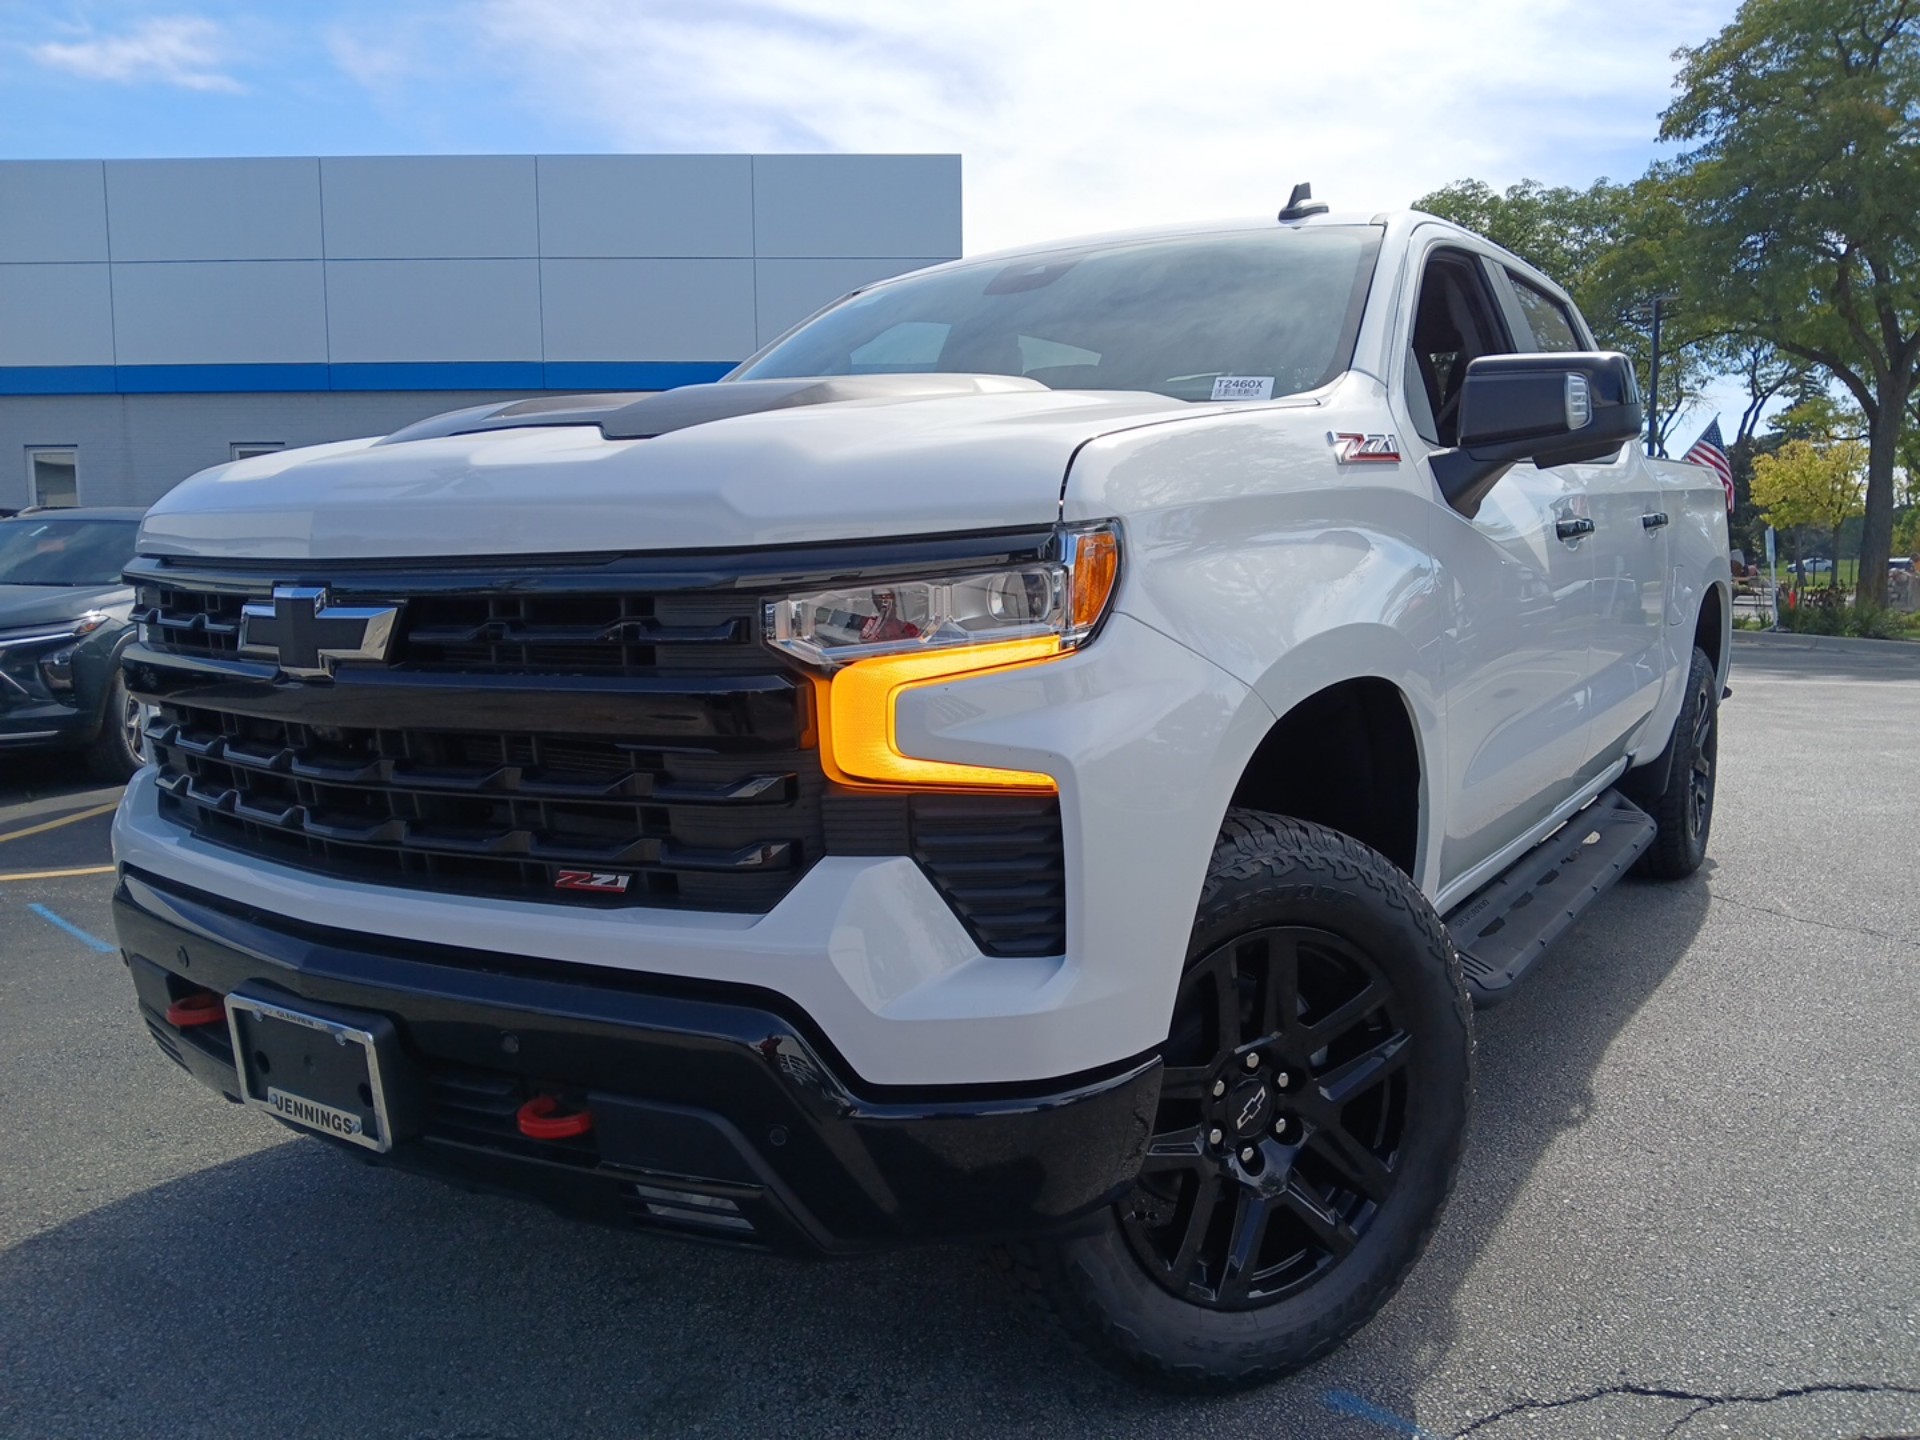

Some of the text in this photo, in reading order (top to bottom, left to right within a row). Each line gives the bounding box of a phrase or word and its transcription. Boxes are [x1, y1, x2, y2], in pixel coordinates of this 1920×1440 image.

[1217, 379, 1264, 389] T2460X
[1327, 431, 1402, 465] Z71
[554, 870, 630, 893] Z71
[275, 1096, 353, 1135] JENNINGS
